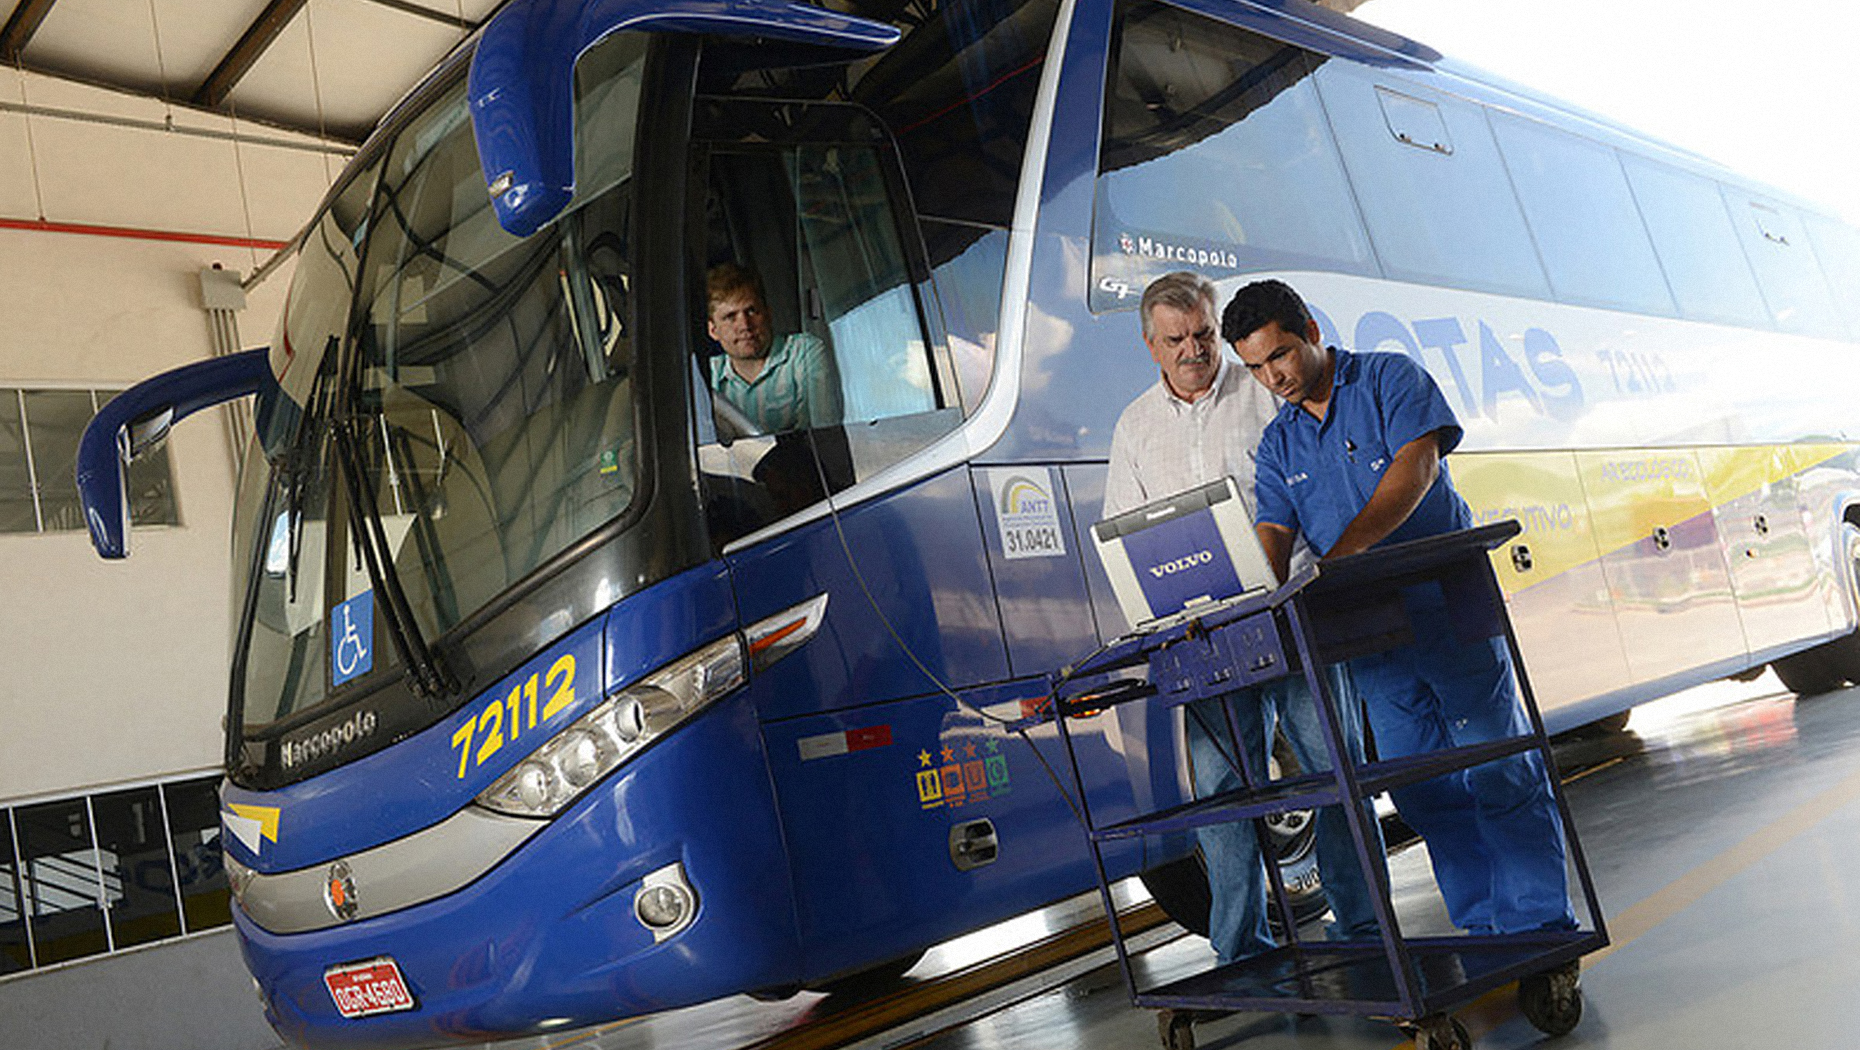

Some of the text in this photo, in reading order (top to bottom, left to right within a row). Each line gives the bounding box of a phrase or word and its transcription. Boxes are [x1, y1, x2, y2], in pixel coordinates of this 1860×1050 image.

[1138, 236, 1237, 268] Marcopolo
[1308, 303, 1584, 423] OTAS
[1006, 528, 1060, 552] 31.0421
[1150, 550, 1213, 578] VOLVO
[452, 654, 577, 779] 72112
[281, 710, 377, 770] Marcopolo
